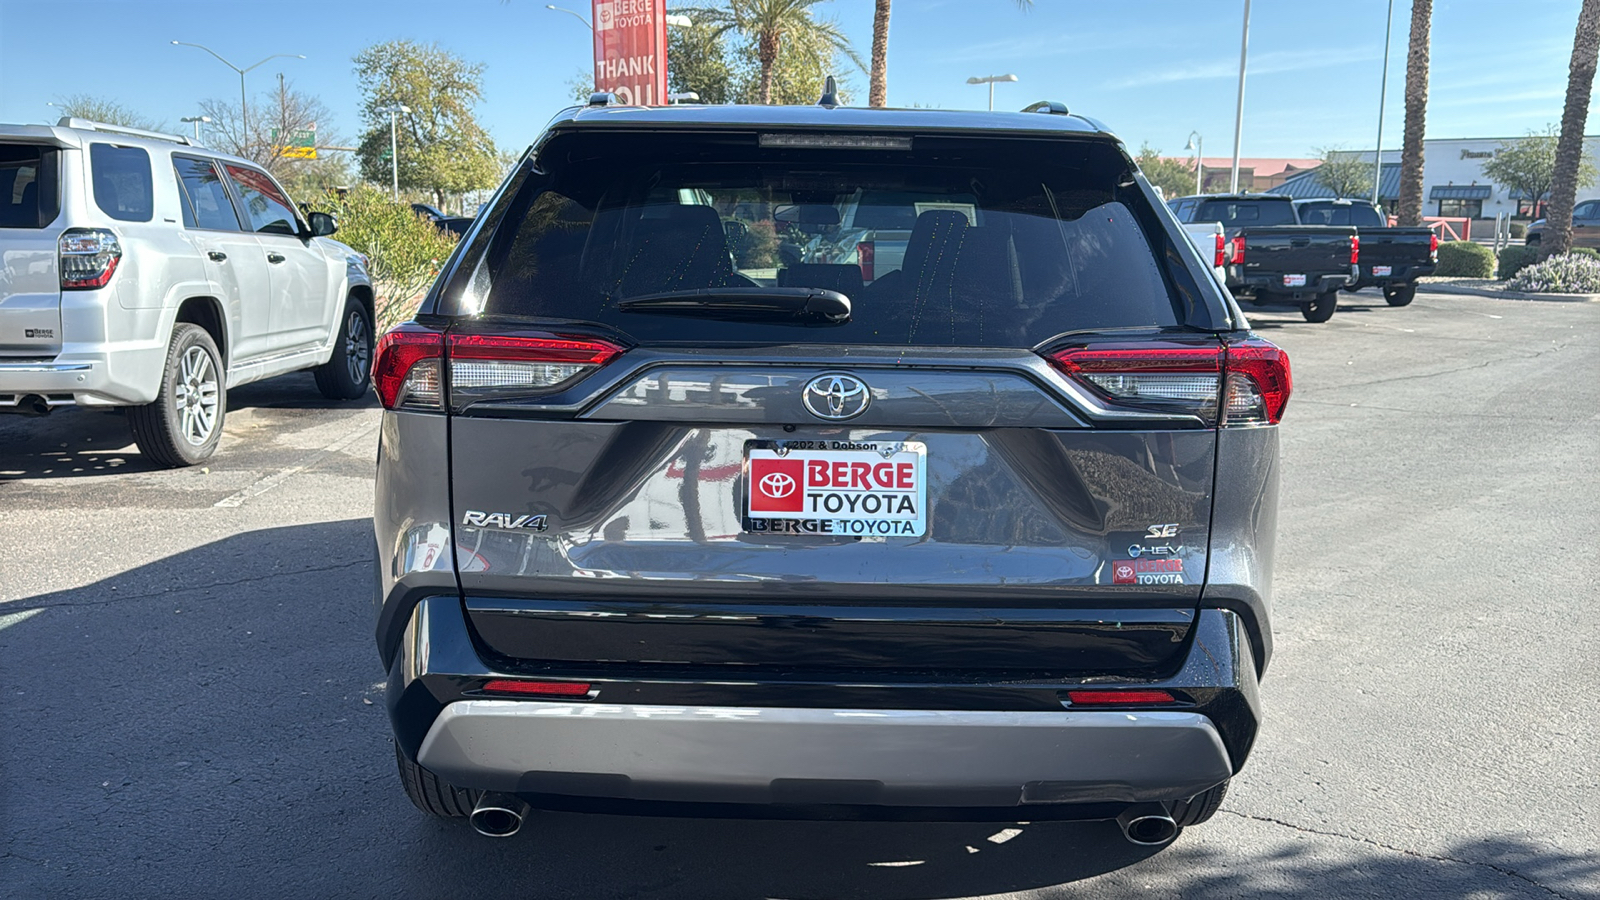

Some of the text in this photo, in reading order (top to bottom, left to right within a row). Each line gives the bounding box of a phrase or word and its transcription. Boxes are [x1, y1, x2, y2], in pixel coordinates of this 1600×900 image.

[614, 0, 652, 16] BERGE
[614, 14, 652, 29] TOYOTA
[597, 55, 654, 79] THANK
[818, 441, 828, 450] &
[832, 441, 878, 451] Dobson
[807, 460, 914, 491] BERGE
[807, 493, 916, 514] TOYOTA
[462, 510, 548, 531] RAV4
[752, 519, 915, 534] BERGE TOYOTA
[1144, 523, 1180, 539] SE
[1137, 558, 1183, 573] BERGE
[1137, 574, 1184, 585] TOYOTA
